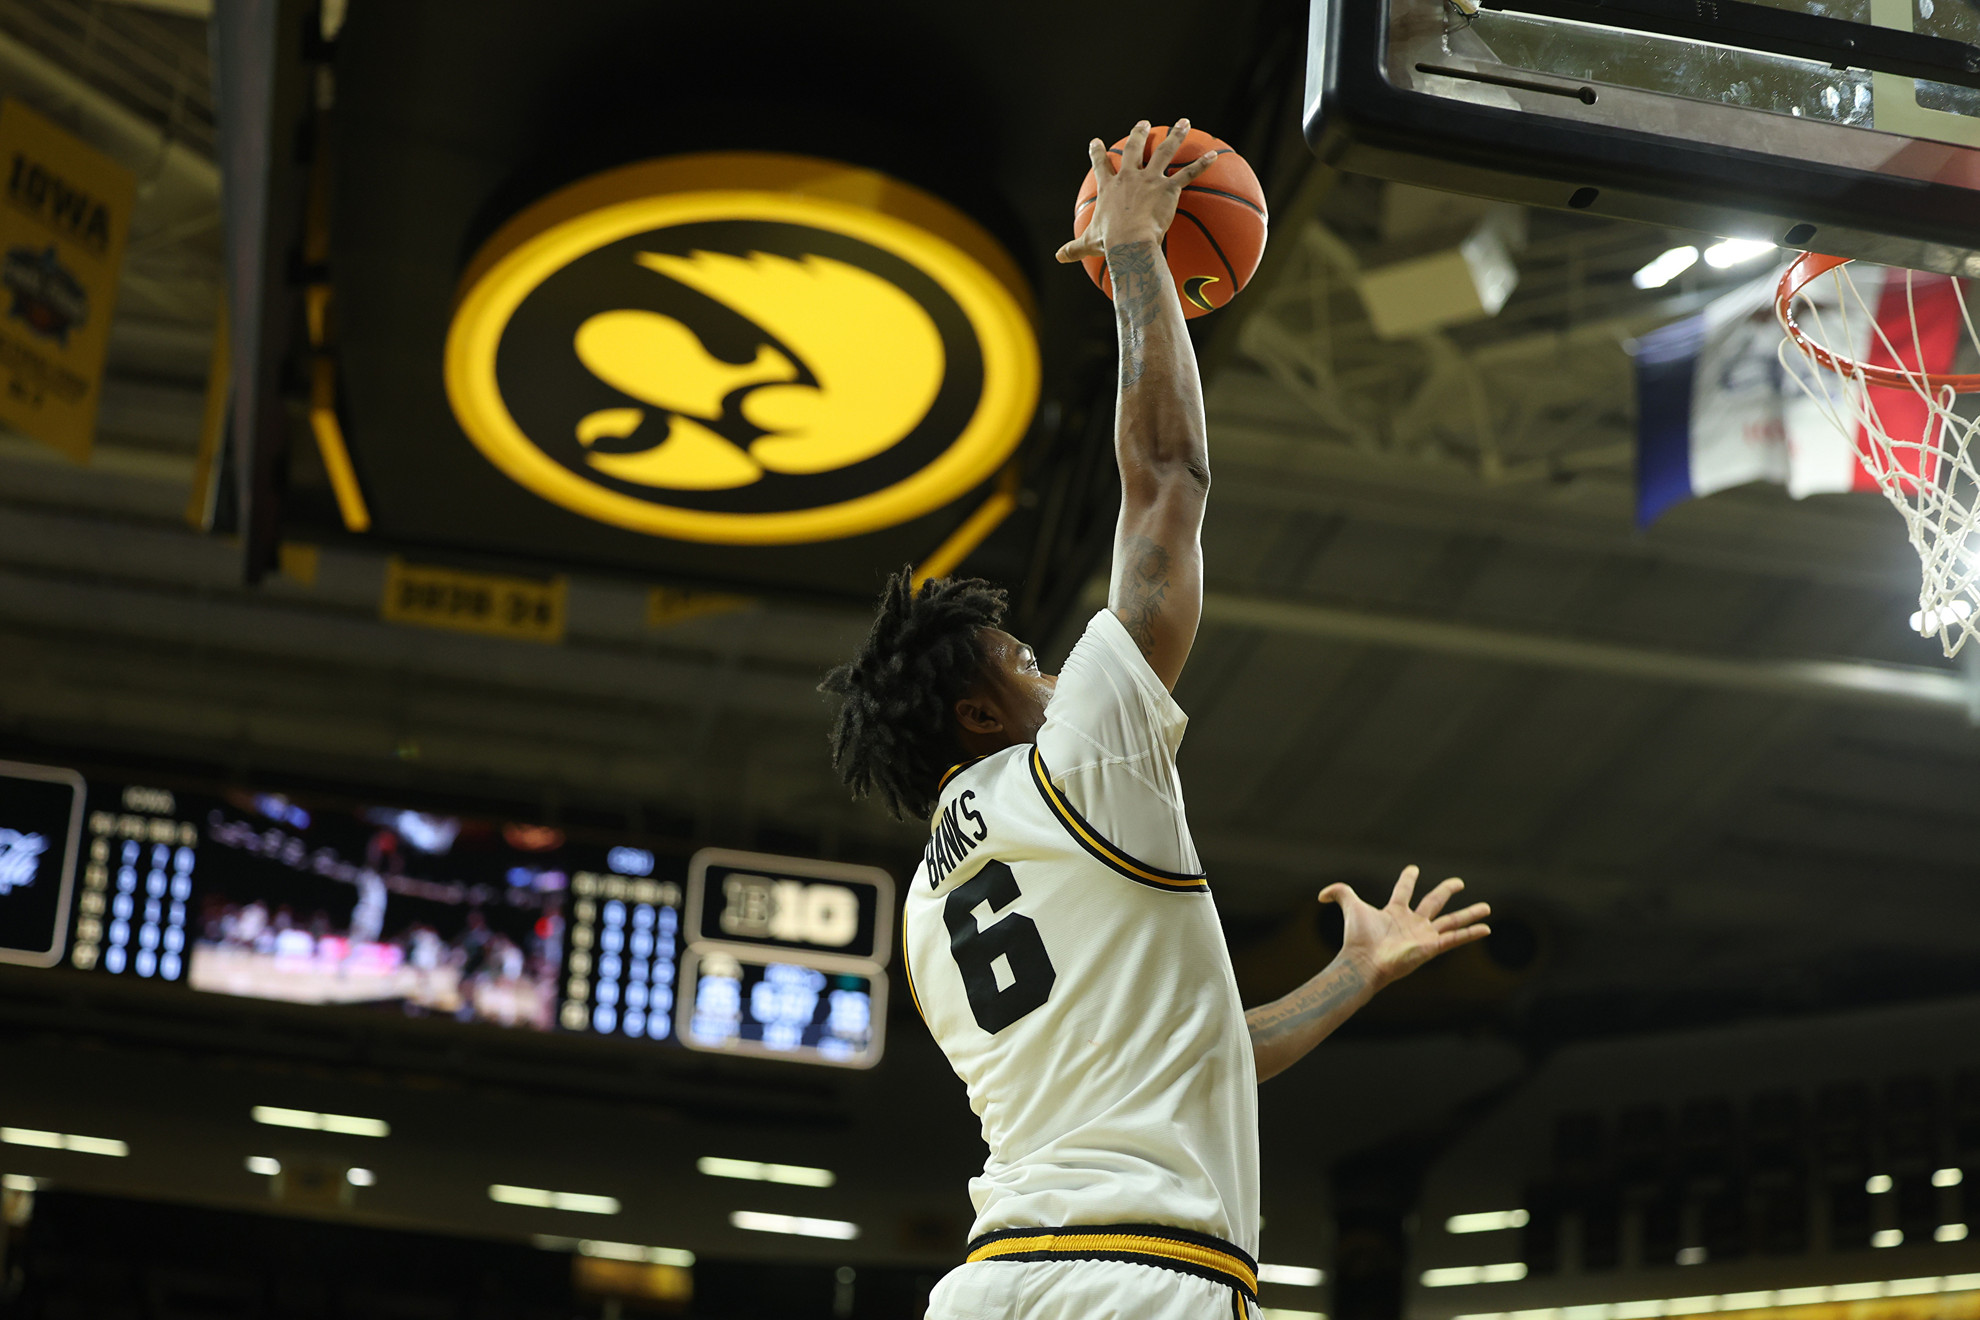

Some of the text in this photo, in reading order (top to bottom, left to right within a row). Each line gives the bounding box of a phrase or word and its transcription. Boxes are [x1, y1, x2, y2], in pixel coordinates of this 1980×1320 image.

[9, 152, 111, 250] IOWA
[925, 789, 988, 891] BANKS
[942, 858, 1057, 1035] 6
